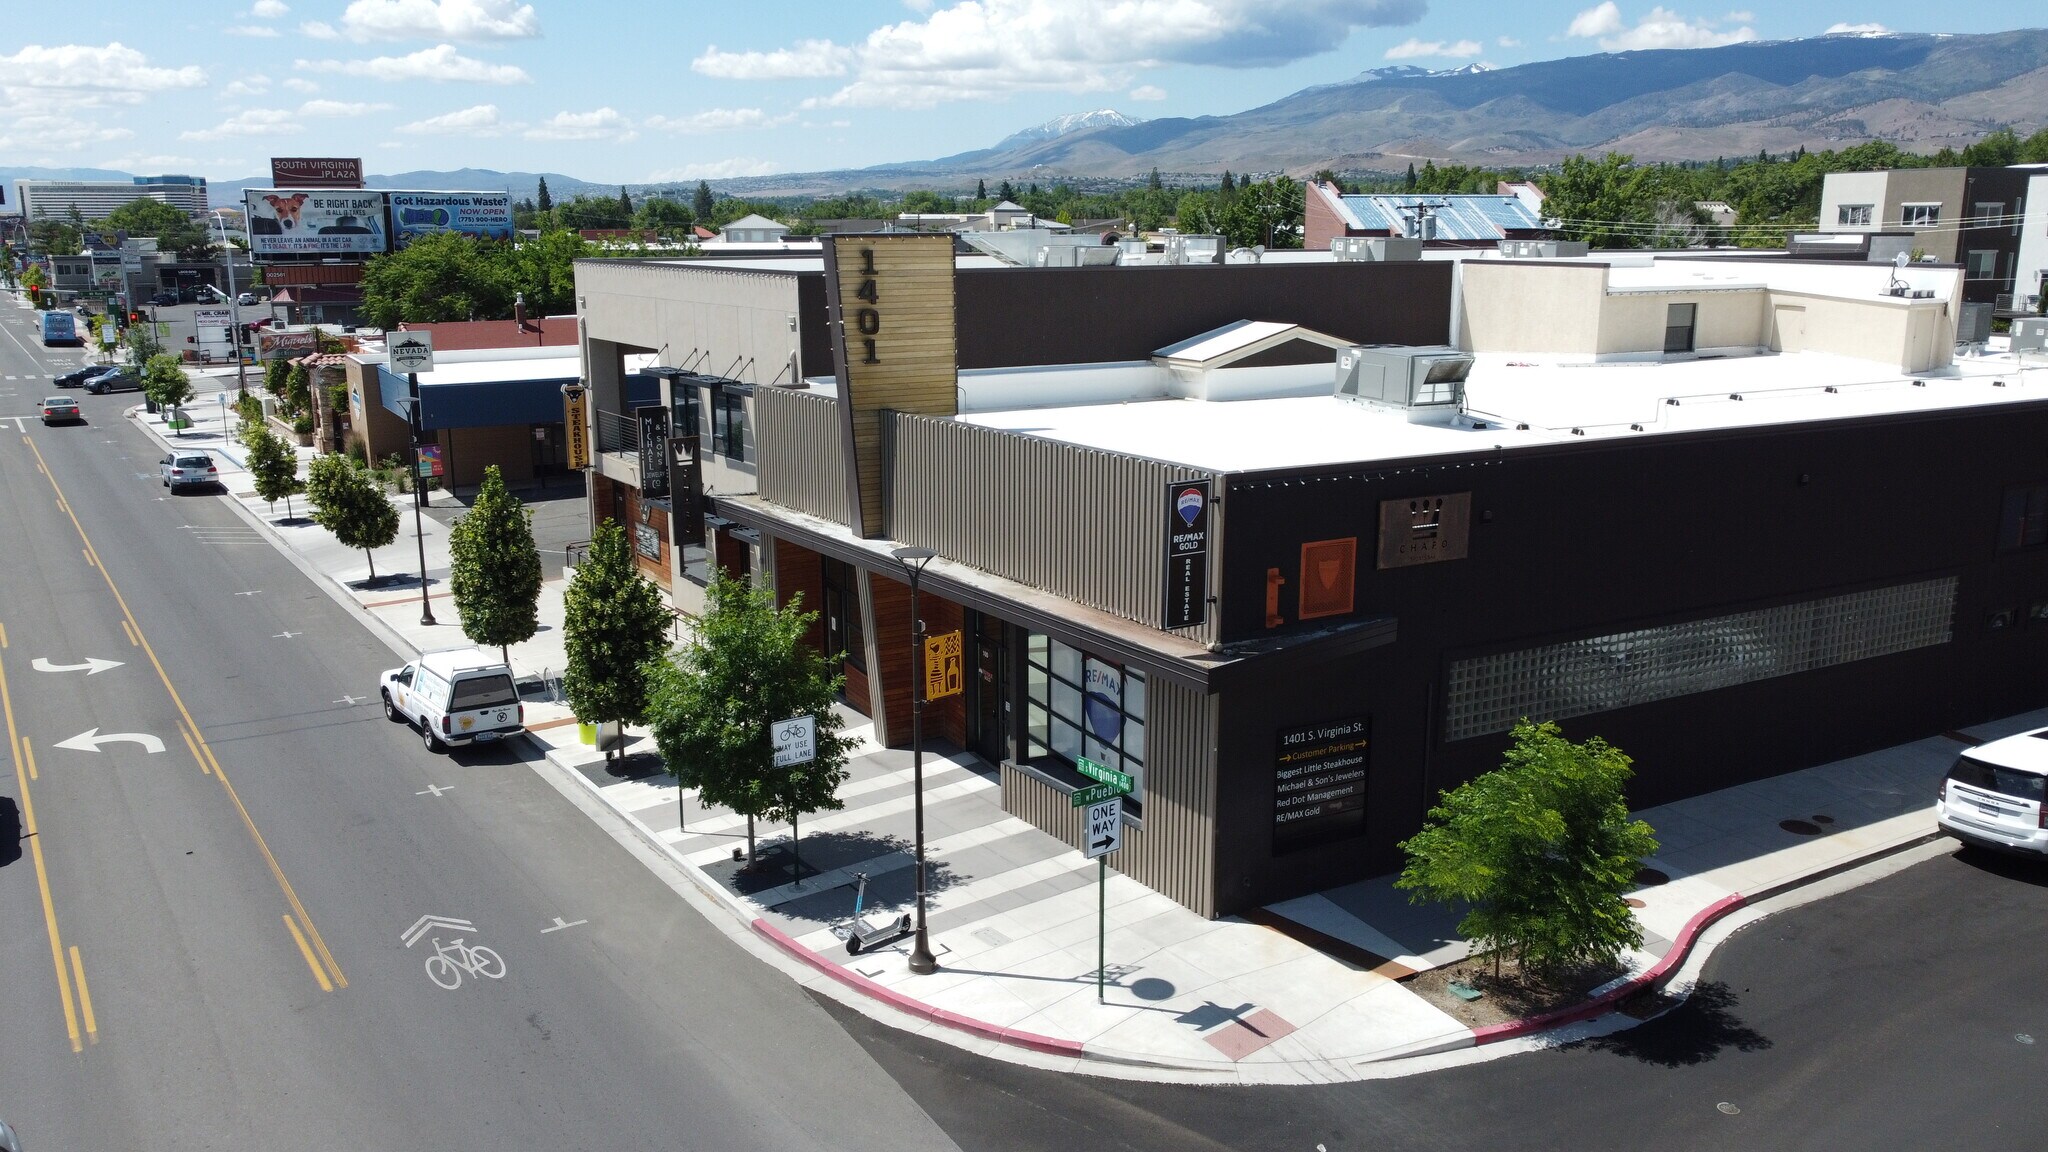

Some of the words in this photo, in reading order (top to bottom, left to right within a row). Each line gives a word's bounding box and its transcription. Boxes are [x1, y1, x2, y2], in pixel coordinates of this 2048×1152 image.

[274, 161, 306, 169] SOUTH
[314, 200, 324, 208] BE
[326, 200, 350, 208] RIGHT
[352, 200, 376, 208] BACK.
[394, 196, 413, 205] Got
[416, 196, 470, 206] Hazardous
[472, 198, 508, 206] Waste?
[857, 250, 881, 364] 1401
[270, 334, 312, 350] Miguel's
[571, 408, 584, 470] STEAKHOUSE
[644, 417, 654, 470] MICHAEL
[1174, 532, 1204, 544] RE/MAX
[1179, 542, 1198, 550] GOLD
[1086, 668, 1122, 696] RE/MAX
[1284, 732, 1306, 745] 1401
[1308, 730, 1316, 740] S.
[1317, 726, 1351, 739] Virginia
[1353, 722, 1364, 732] St.
[795, 740, 808, 749] USE
[1292, 747, 1327, 760] Customer
[1328, 742, 1354, 753] Parking
[776, 754, 792, 763] FULL
[795, 749, 812, 759] LANE
[1088, 762, 1117, 785] Virginia
[1277, 767, 1302, 779] Biggest
[1304, 763, 1322, 774] Little
[1323, 756, 1363, 770] Steakhouse
[1278, 780, 1306, 793] Michael
[1308, 778, 1314, 786] &
[1315, 775, 1334, 785] Son's
[1335, 769, 1364, 782] Jewelers
[1091, 785, 1120, 798] Pueblo
[1277, 797, 1290, 808] Red
[1292, 795, 1305, 805] Dot
[1307, 786, 1353, 802] Management
[1093, 804, 1116, 821] ONE
[1276, 810, 1303, 822] RE/MAX
[1305, 807, 1320, 816] Gold
[1092, 818, 1116, 836] WAY
